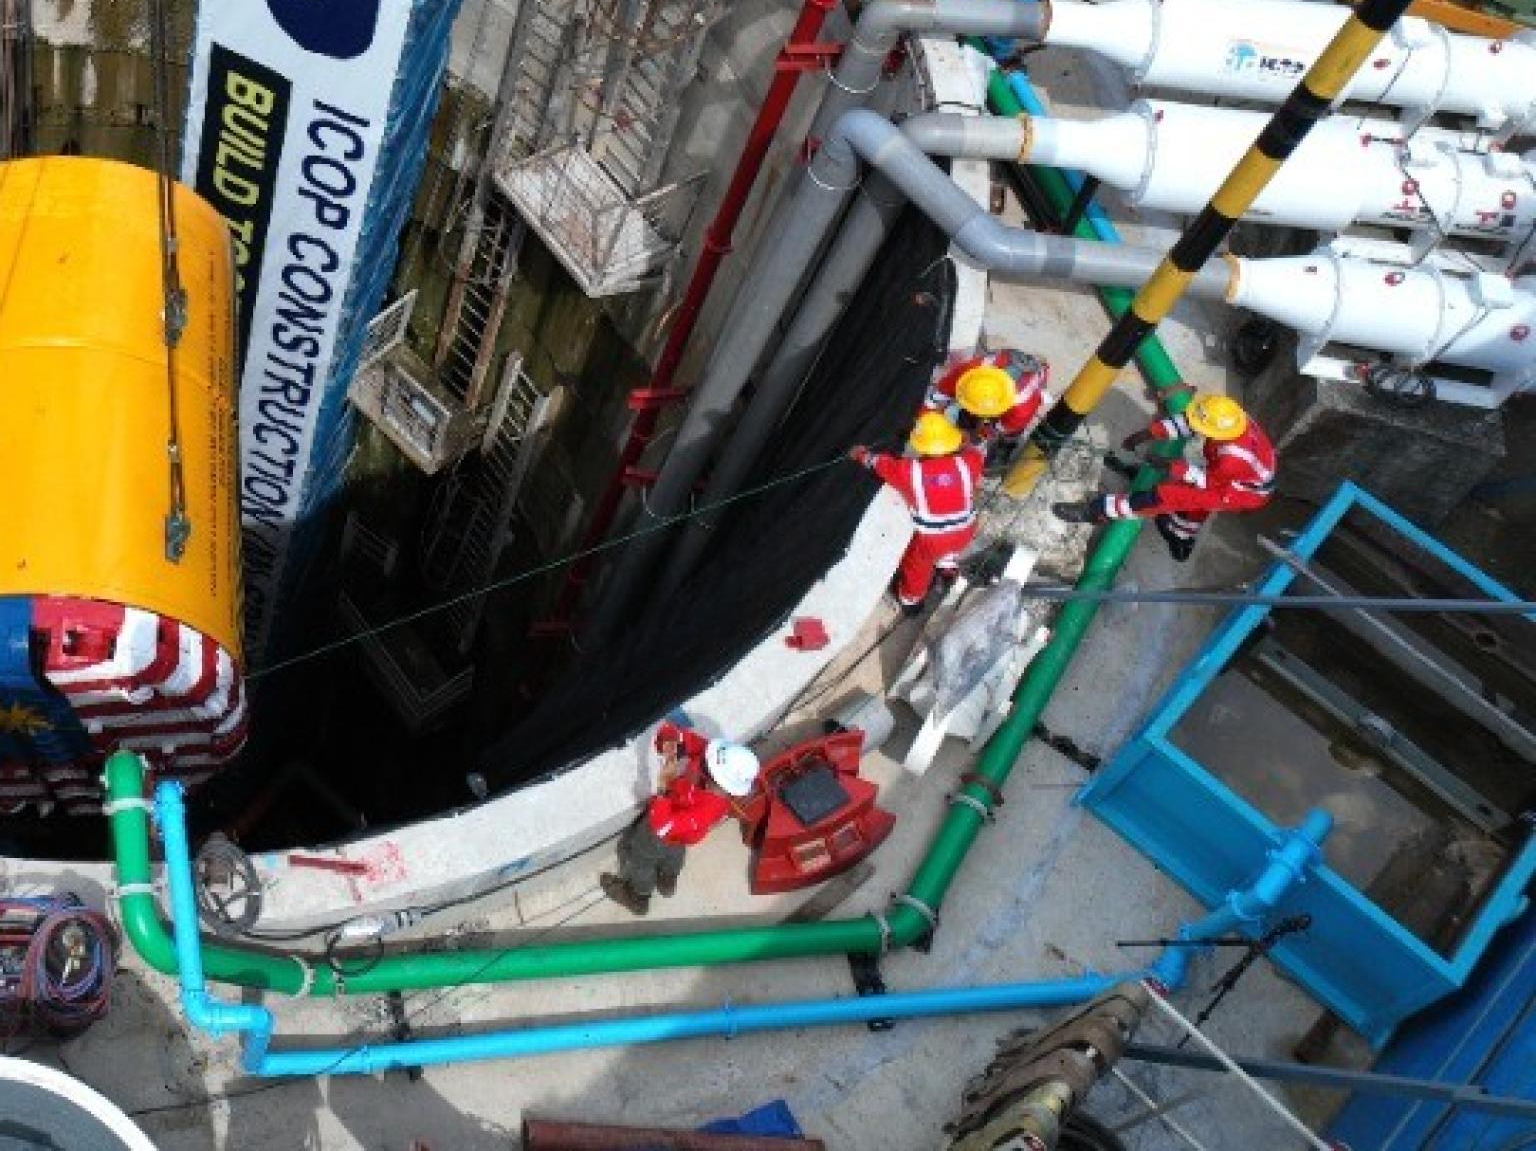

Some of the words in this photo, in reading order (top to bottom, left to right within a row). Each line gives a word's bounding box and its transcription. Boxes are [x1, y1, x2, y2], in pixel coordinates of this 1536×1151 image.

[213, 69, 277, 206] BUILD
[297, 98, 371, 231] ICOP
[242, 232, 339, 532] CONSTRUCTION
